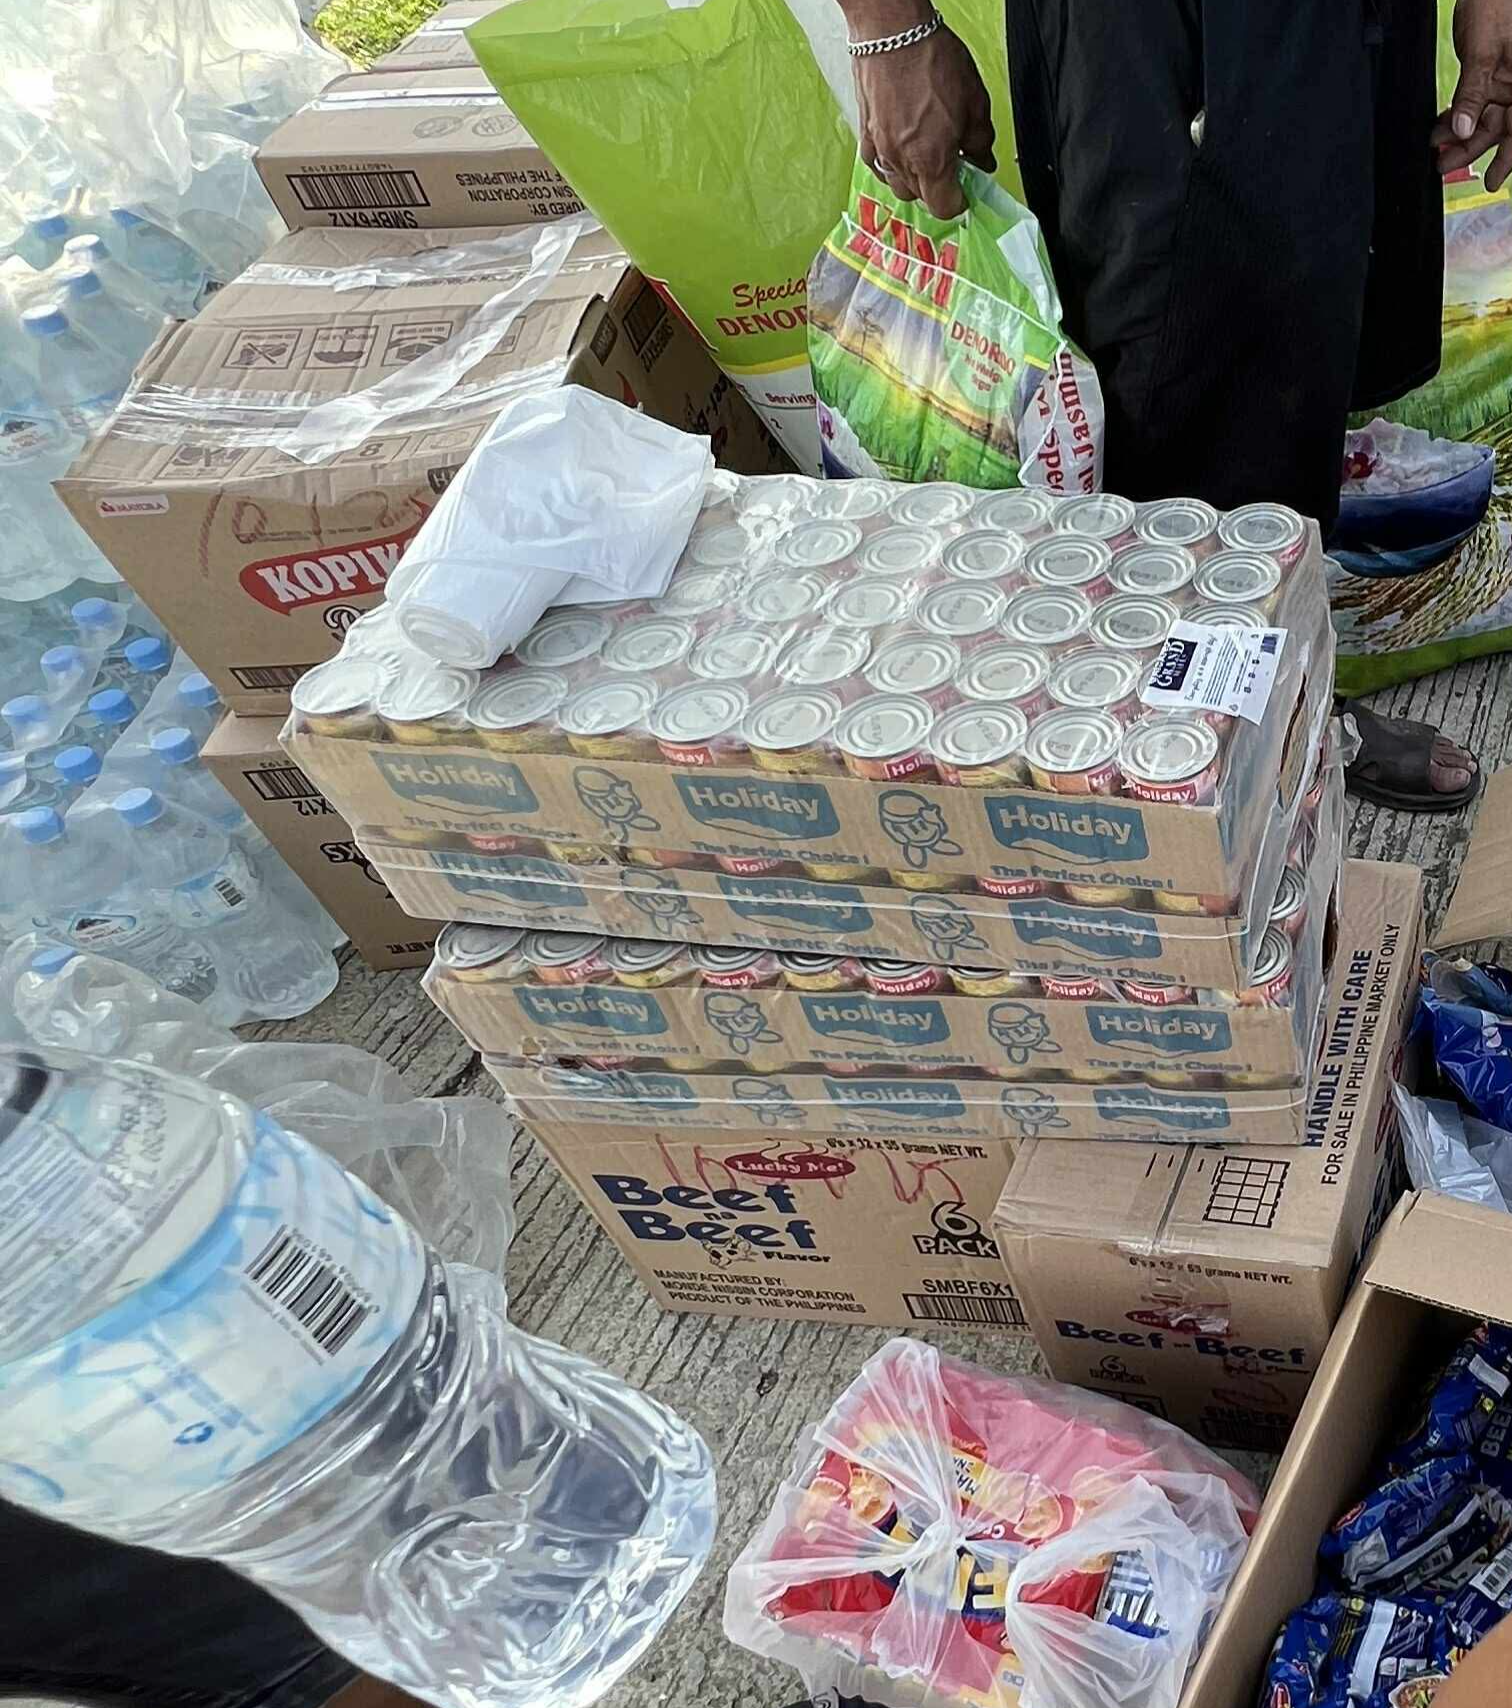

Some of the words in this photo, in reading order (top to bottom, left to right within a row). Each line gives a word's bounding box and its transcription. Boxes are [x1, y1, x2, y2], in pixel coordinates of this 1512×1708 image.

[454, 172, 537, 187] PHILIPPINES
[537, 168, 558, 185] THE
[467, 186, 561, 202] CORPORATION
[386, 762, 518, 797] Holiday
[688, 786, 819, 821] Holiday
[999, 804, 1133, 846] Holiday
[797, 849, 860, 865] Choice
[990, 864, 1027, 877] The
[1029, 864, 1097, 884] Perfect
[1099, 872, 1163, 889] Choice
[1382, 922, 1401, 957] ONLY
[1342, 949, 1372, 1003] CARE
[1365, 960, 1392, 1018] MARKET
[529, 995, 649, 1022] Holiday
[813, 1004, 934, 1031] Holiday
[1099, 1014, 1218, 1041] Holiday
[1327, 1006, 1359, 1056] WITH
[1345, 1015, 1378, 1093] PHILIPPINE
[835, 1086, 950, 1108] Holiday
[1304, 1064, 1343, 1148] HANDLE
[1342, 1092, 1359, 1107] IN
[1332, 1108, 1354, 1150] SALE
[900, 1142, 938, 1155] grams
[937, 1144, 962, 1157] NET
[963, 1146, 989, 1159] WT.
[735, 1159, 801, 1175] Lucky
[807, 1158, 846, 1174] Me!
[1321, 1151, 1344, 1186] FOR
[592, 1174, 798, 1214] Beef
[617, 1209, 818, 1250] Beef
[704, 1211, 739, 1221] na
[930, 1200, 982, 1237] 6
[763, 1249, 832, 1263] Flavor
[653, 1269, 762, 1286] MANUFACTURED
[922, 1278, 1015, 1297] SMBF6X1
[1204, 1266, 1242, 1279] grams
[1243, 1269, 1268, 1282] NET
[1270, 1272, 1294, 1285] WT.
[662, 1280, 711, 1293] MONDE
[712, 1282, 757, 1297] NISSIN
[758, 1285, 856, 1302] CORPORATION
[669, 1290, 725, 1305] PRODUCT
[726, 1294, 749, 1305] OF
[750, 1296, 782, 1308] THE
[781, 1299, 867, 1314] PHILIPPINES
[1055, 1318, 1164, 1350] Beef
[1194, 1336, 1307, 1365] Beef
